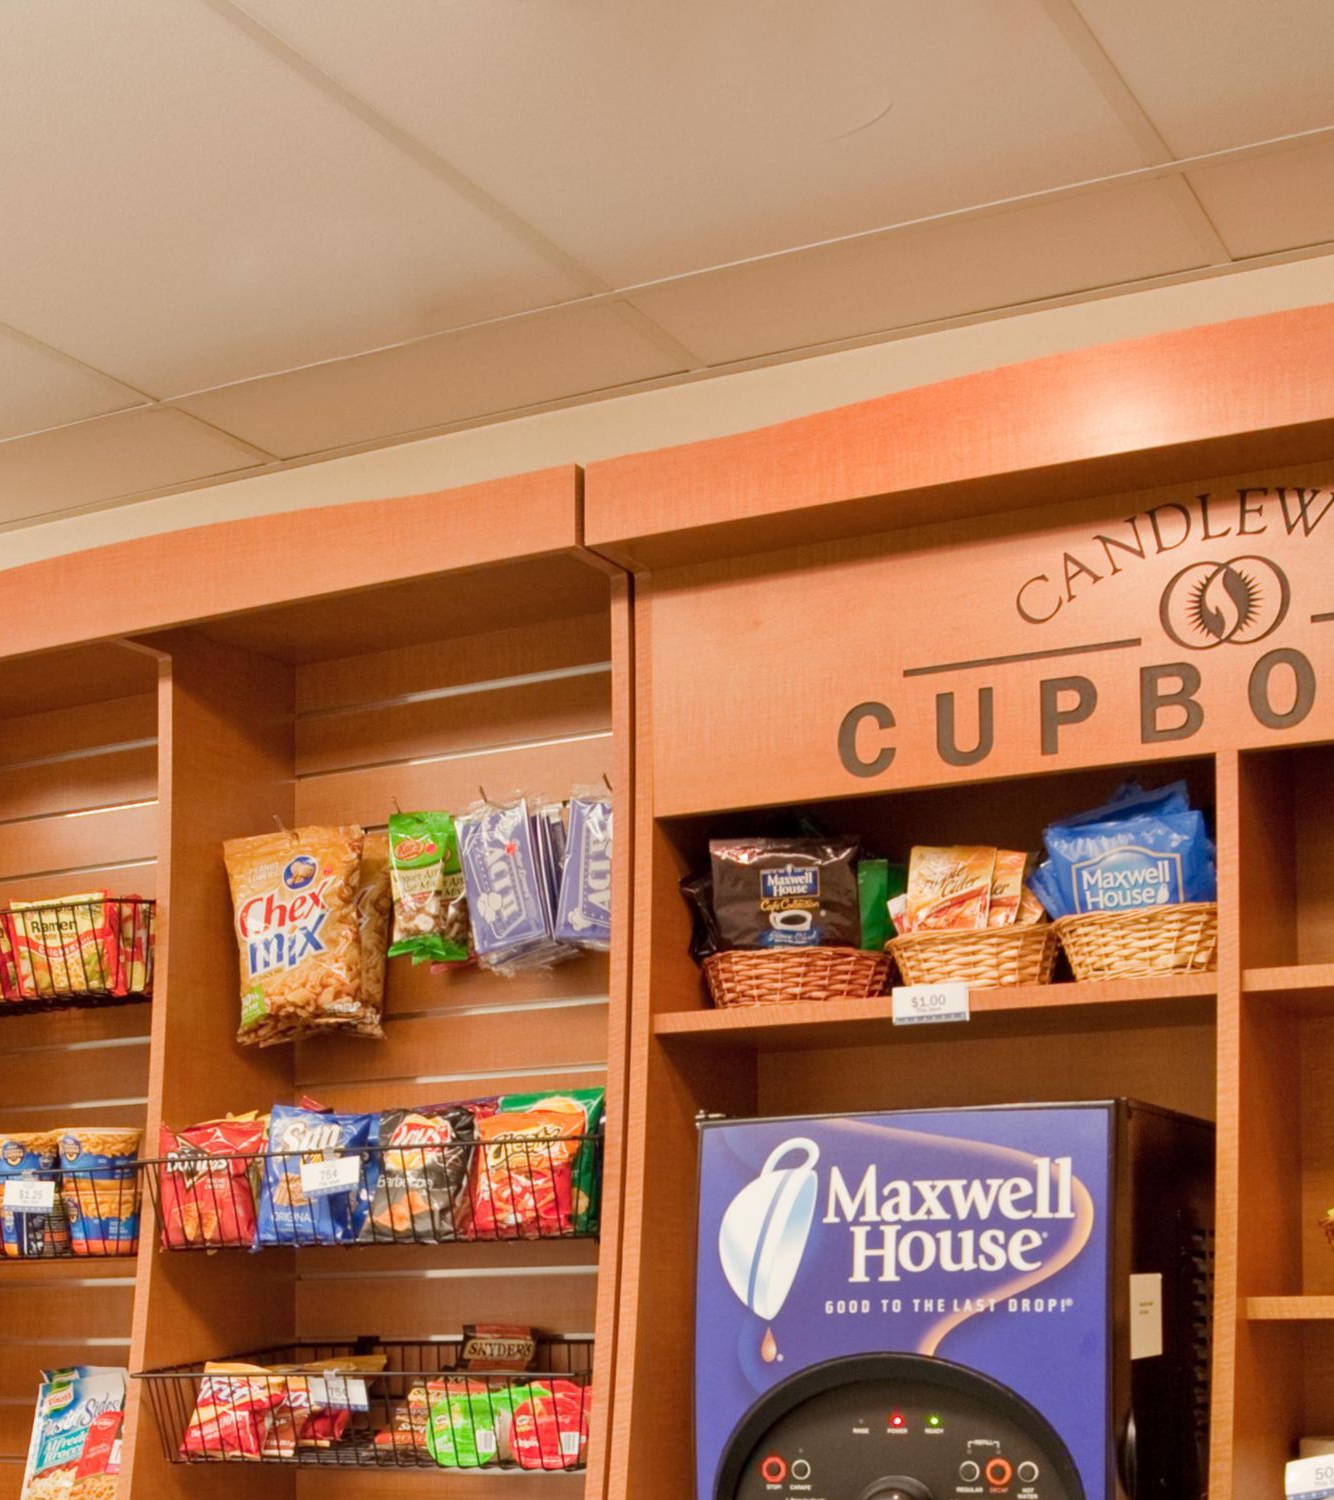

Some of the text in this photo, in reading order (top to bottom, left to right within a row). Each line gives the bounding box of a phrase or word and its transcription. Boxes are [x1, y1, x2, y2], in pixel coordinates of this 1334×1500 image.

[767, 872, 812, 886] Maxwell
[942, 876, 980, 897] Cider
[1082, 861, 1169, 890] Maxwell
[773, 885, 808, 897] House
[1085, 885, 1157, 912] House
[239, 880, 330, 938] Chex
[31, 919, 76, 934] Ramen
[249, 913, 325, 974] mix
[911, 994, 947, 1008] $1.00
[281, 1119, 343, 1153] Sun
[319, 1169, 339, 1181] 75¢
[823, 1157, 1075, 1224] Maxwell
[848, 1224, 1041, 1282] House
[824, 1300, 871, 1314] GOOD
[880, 1299, 904, 1313] TO
[912, 1299, 947, 1313] THE
[952, 1298, 997, 1313] LAST
[467, 1340, 533, 1359] SNYDER'S
[81, 1391, 118, 1426] Sides
